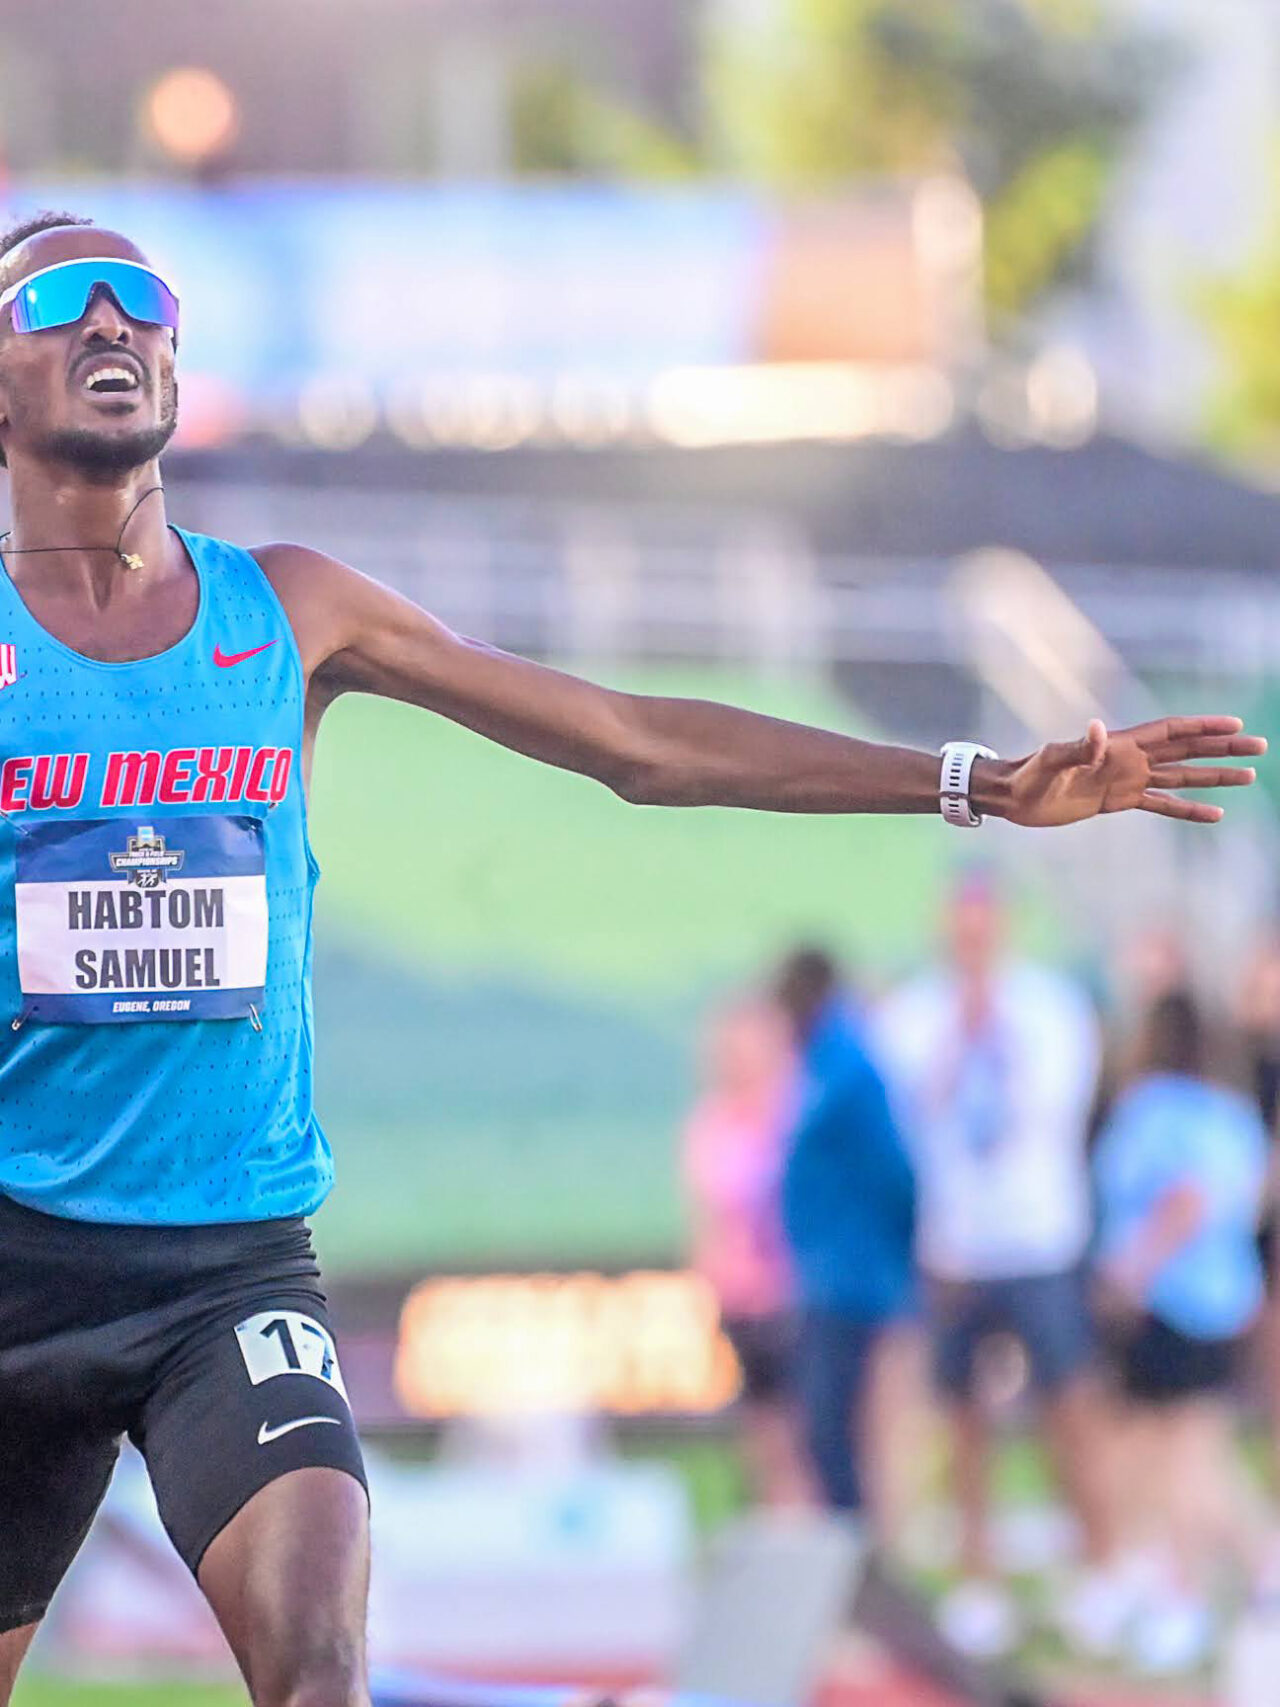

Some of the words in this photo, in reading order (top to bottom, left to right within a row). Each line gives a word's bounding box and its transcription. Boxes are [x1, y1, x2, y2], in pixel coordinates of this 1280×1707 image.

[99, 747, 293, 808] MEXICO
[68, 888, 224, 930] HABTOM
[75, 948, 220, 989] SAMUEL
[112, 1001, 151, 1014] EUGENE,
[152, 999, 191, 1012] OREGON
[259, 1319, 334, 1380] 17
